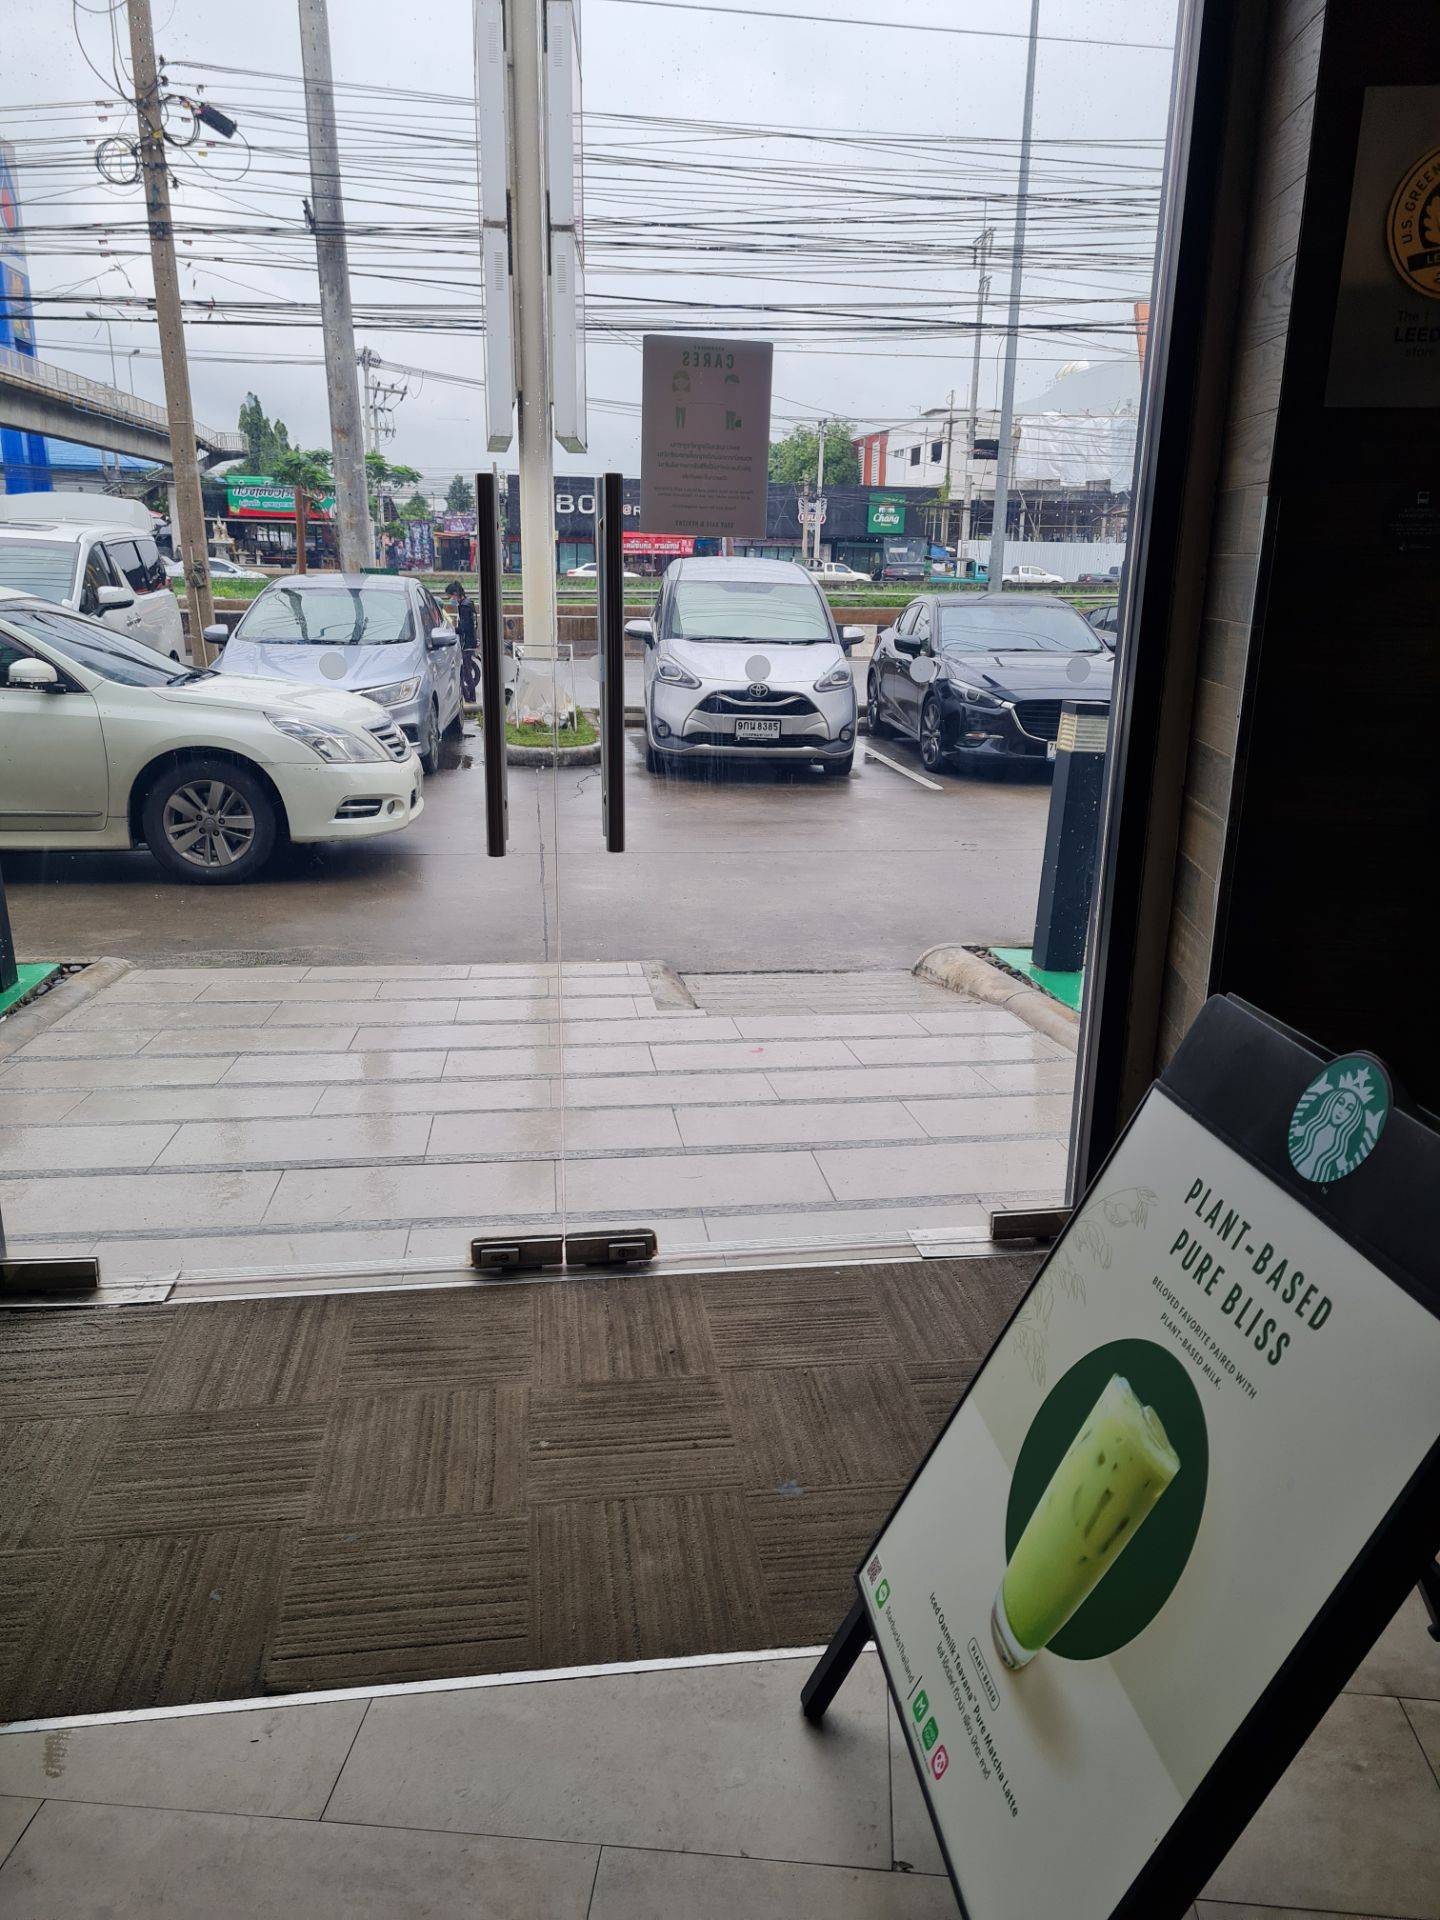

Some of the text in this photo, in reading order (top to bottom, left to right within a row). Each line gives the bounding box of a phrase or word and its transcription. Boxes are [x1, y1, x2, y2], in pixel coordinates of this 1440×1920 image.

[1394, 326, 1440, 343] LEED
[873, 513, 900, 525] Chang
[757, 722, 779, 731] 8385
[1184, 1177, 1334, 1331] PLANT-BASED
[1169, 1229, 1291, 1367] PURE BLISS
[1152, 1275, 1258, 1400] BELOVED FAVORITE PAIRED WITH
[1160, 1312, 1204, 1366] PLANT-BASED
[971, 1645, 996, 1702] PLANT-BASED
[930, 1592, 942, 1615] Iced
[938, 1613, 957, 1657] Oatmilk
[973, 1704, 986, 1735] Pure
[984, 1733, 1004, 1781] Matcha
[1002, 1780, 1018, 1818] Latte
